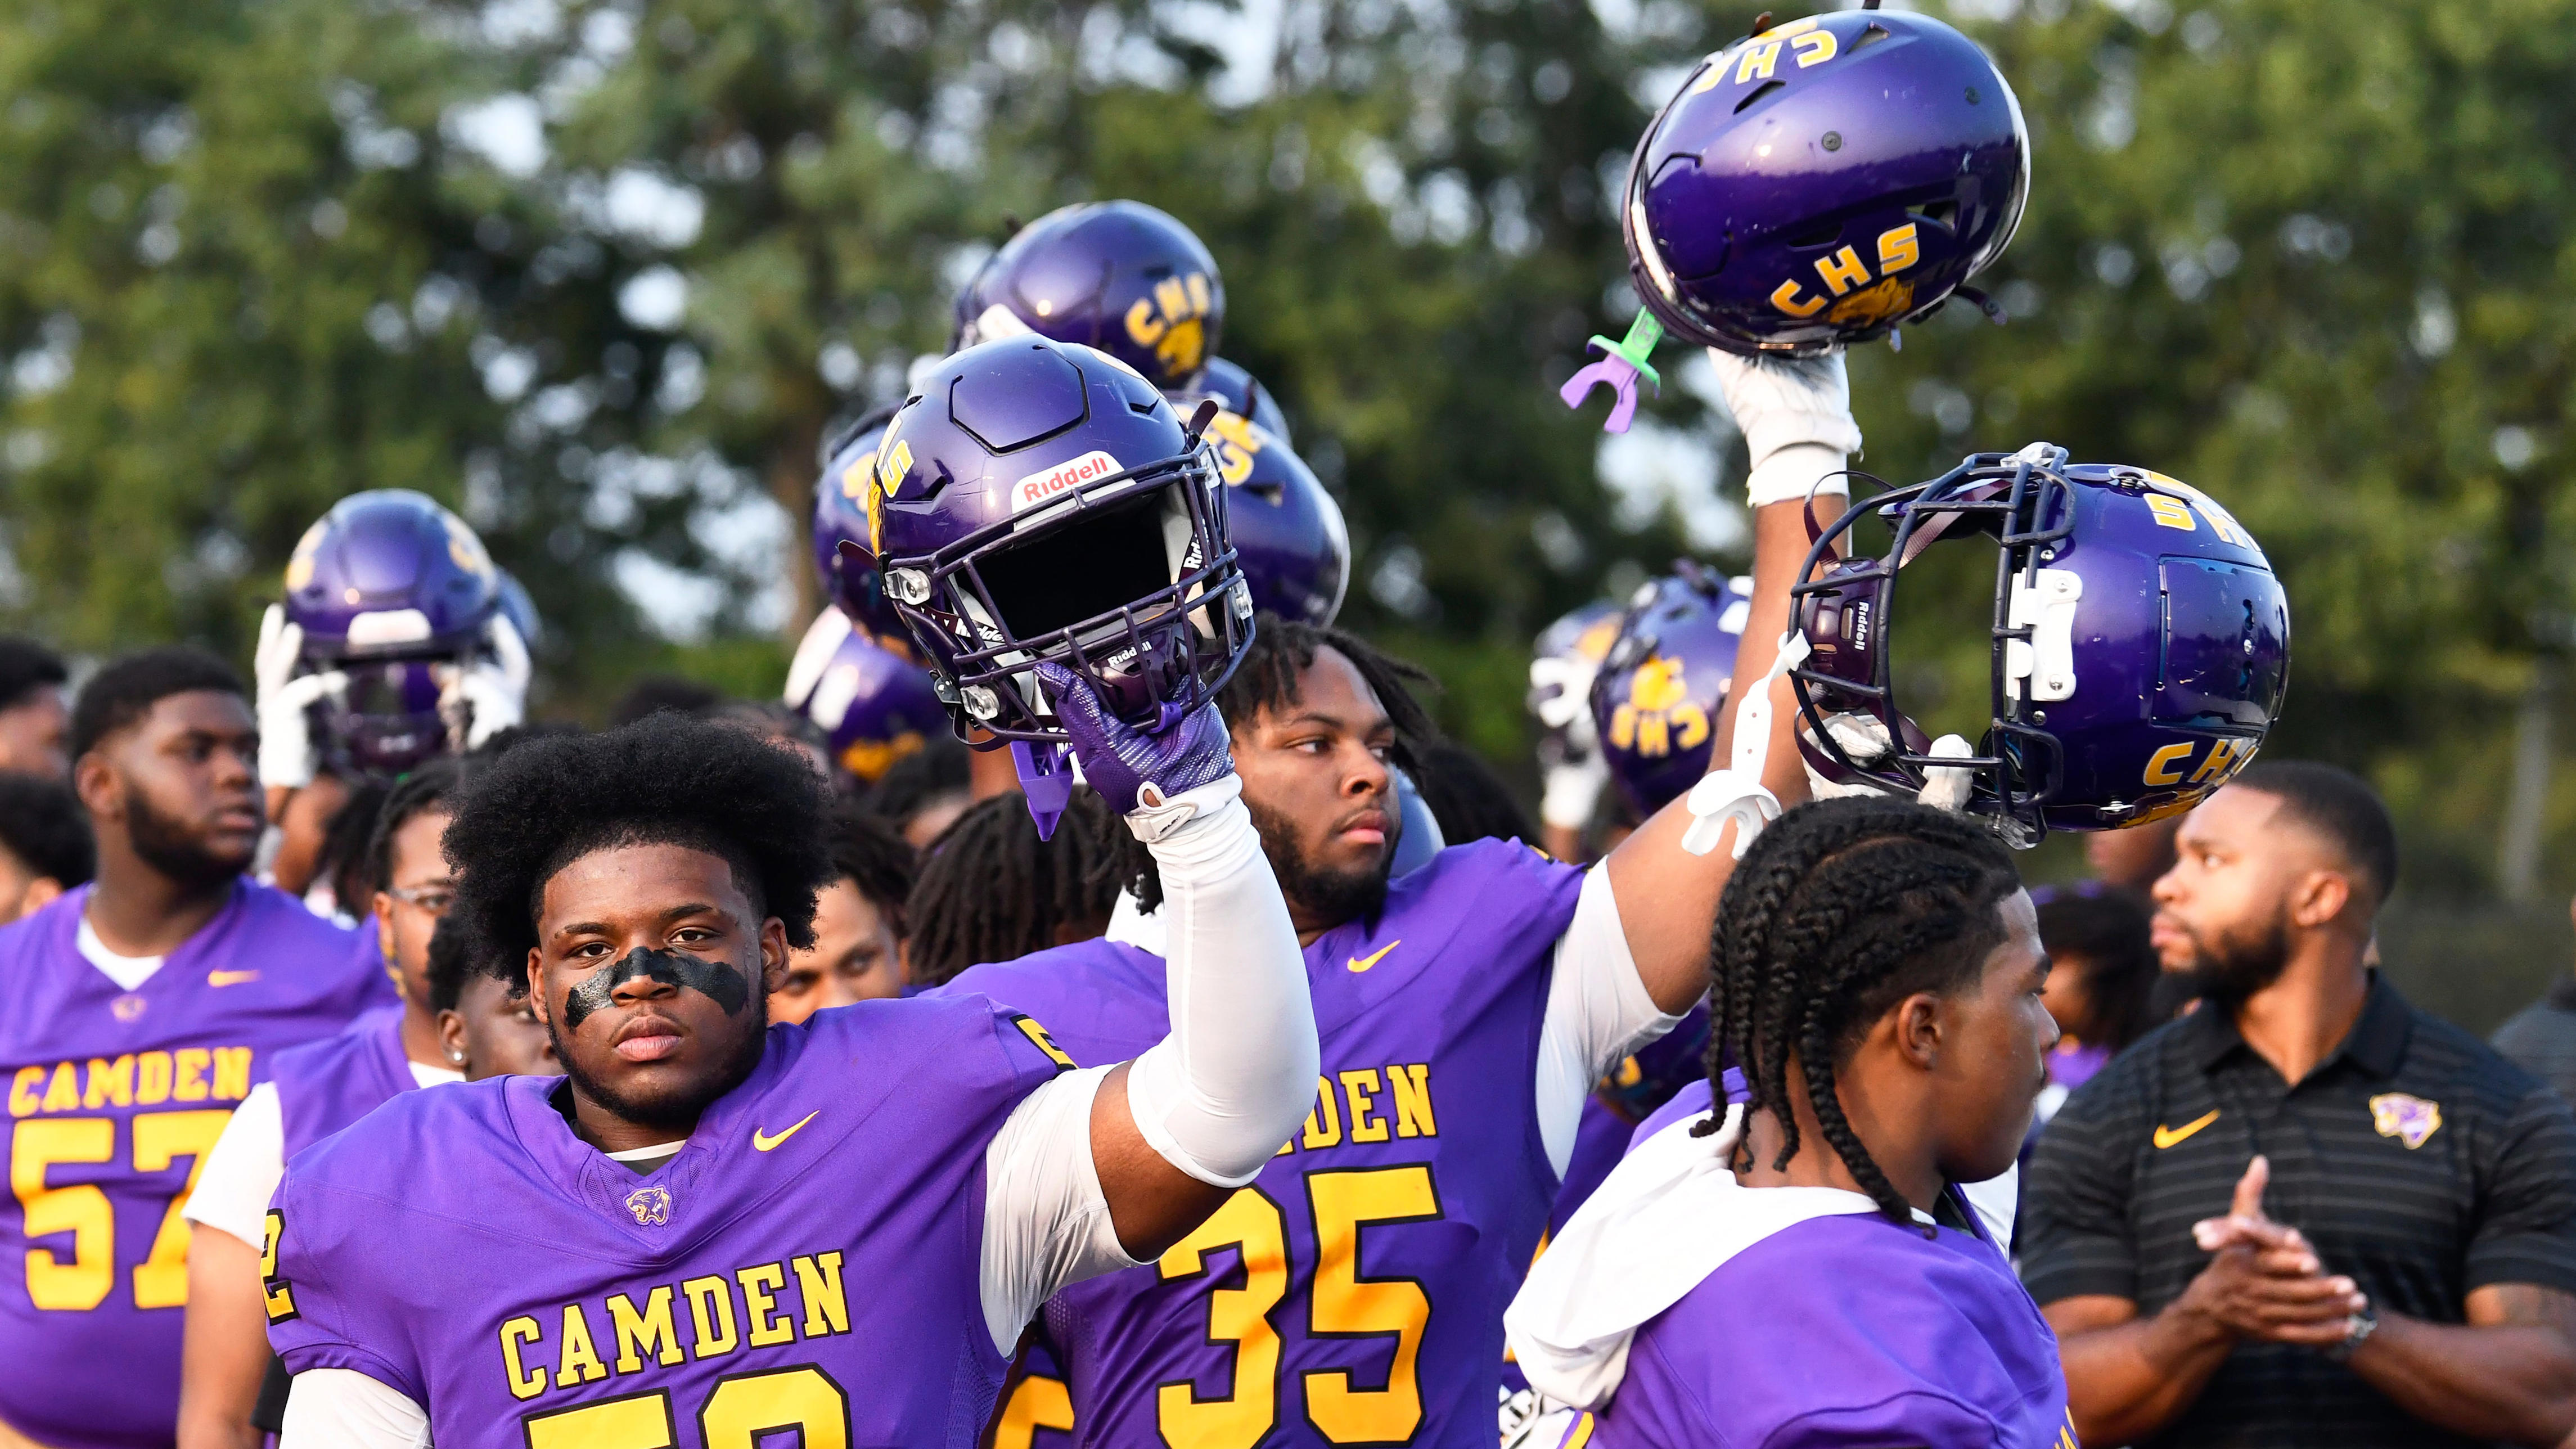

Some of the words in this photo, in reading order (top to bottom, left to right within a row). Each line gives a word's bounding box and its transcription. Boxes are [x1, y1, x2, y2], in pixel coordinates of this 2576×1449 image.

[1770, 222, 1919, 317] CHS
[1024, 457, 1108, 502] Riddell
[2143, 492, 2262, 552] HS
[1107, 641, 1152, 667] Riddll
[1854, 601, 1869, 650] Riddell
[9, 1047, 252, 1117] CAMDEN
[1276, 1063, 1437, 1156] DEN
[11, 1109, 235, 1311] 57
[499, 1249, 852, 1401] CAMDEN
[1156, 1161, 1445, 1449] 35
